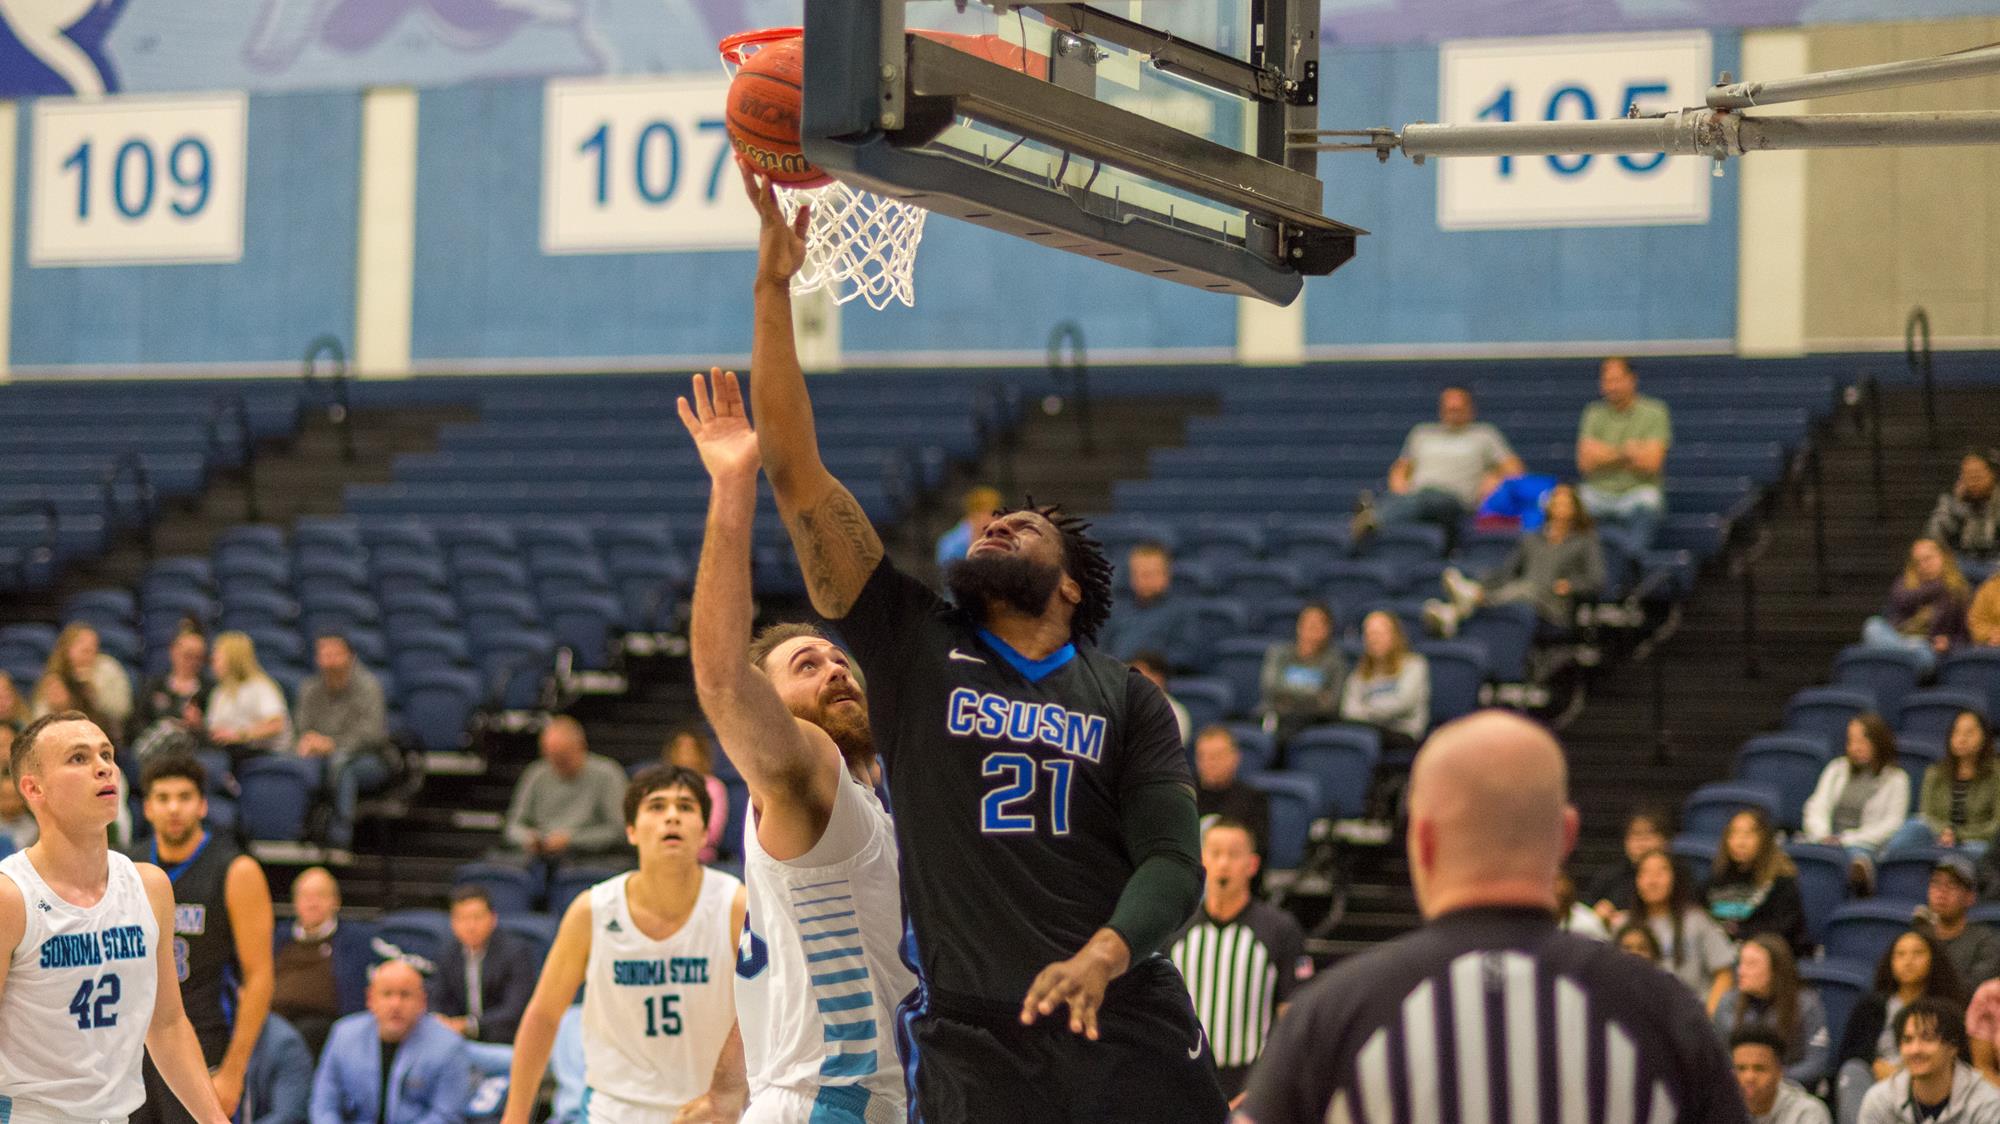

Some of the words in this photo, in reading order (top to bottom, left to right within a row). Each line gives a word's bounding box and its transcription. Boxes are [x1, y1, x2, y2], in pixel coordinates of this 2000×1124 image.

[579, 118, 735, 204] 107
[1476, 82, 1668, 177] 105
[62, 137, 213, 220] 109
[948, 687, 1107, 763] CSUSM
[981, 752, 1074, 835] 21
[40, 931, 102, 969] SONOMA
[102, 924, 147, 961] STATE
[613, 959, 667, 986] SONOMA
[670, 956, 709, 984] STATE
[69, 973, 121, 1030] 42
[644, 994, 683, 1037] 15
